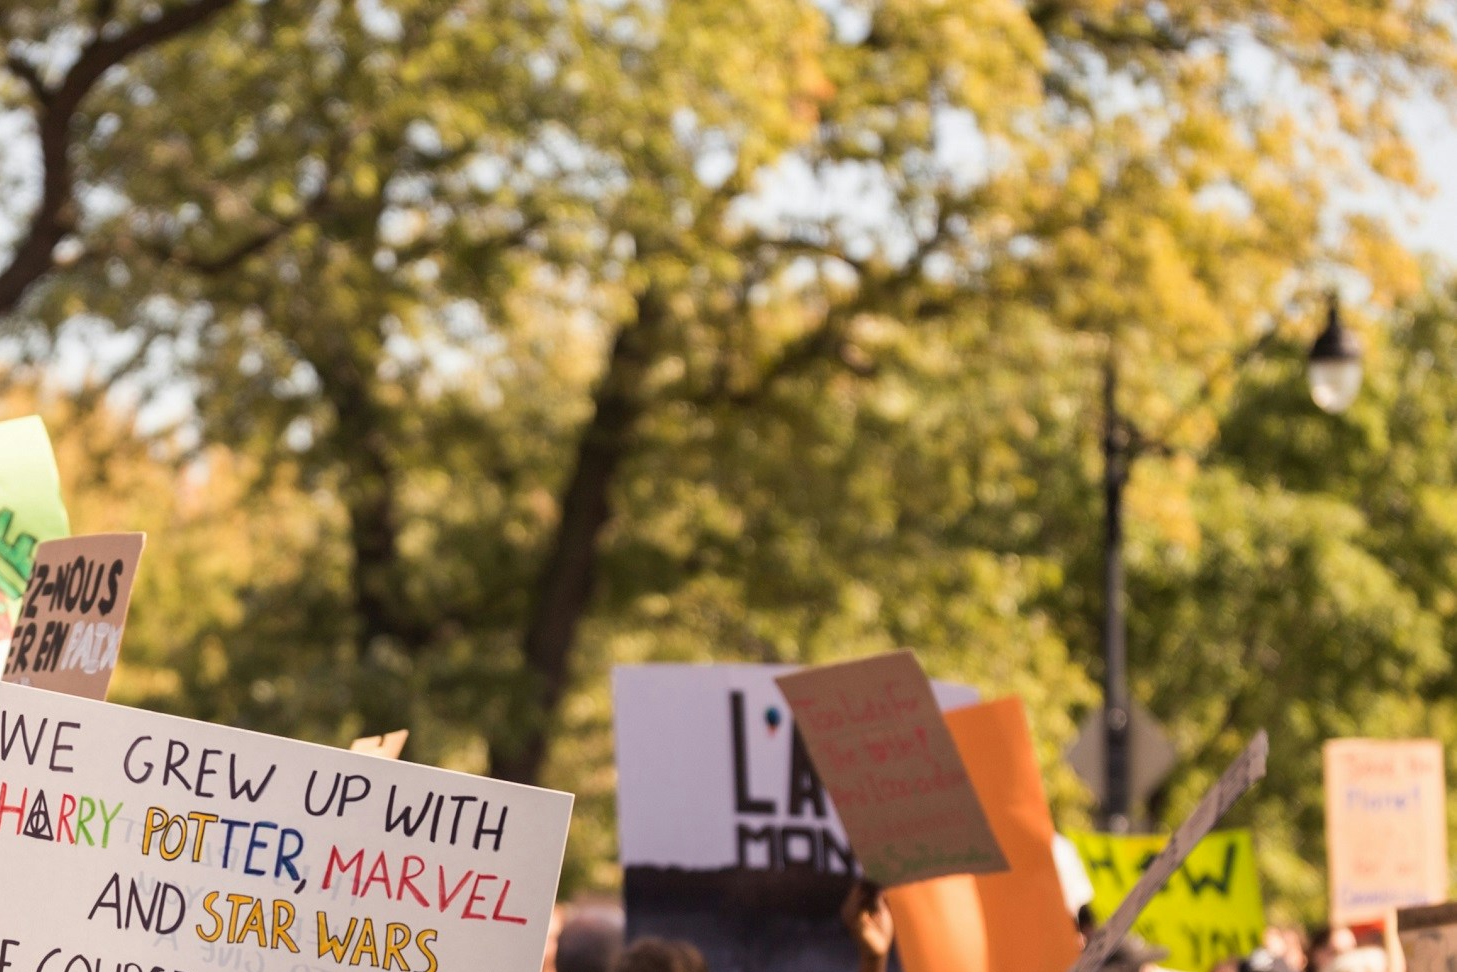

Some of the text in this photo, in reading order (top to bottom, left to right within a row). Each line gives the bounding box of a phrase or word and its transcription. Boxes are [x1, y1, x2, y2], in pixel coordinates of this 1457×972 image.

[20, 556, 124, 618] Z-NOUS
[33, 621, 70, 672] EN
[0, 711, 508, 852] WE GREW UP WITH
[142, 806, 309, 895] POTTER,
[322, 844, 528, 925] MARVEL
[88, 873, 186, 935] AND
[196, 891, 300, 954] STAR
